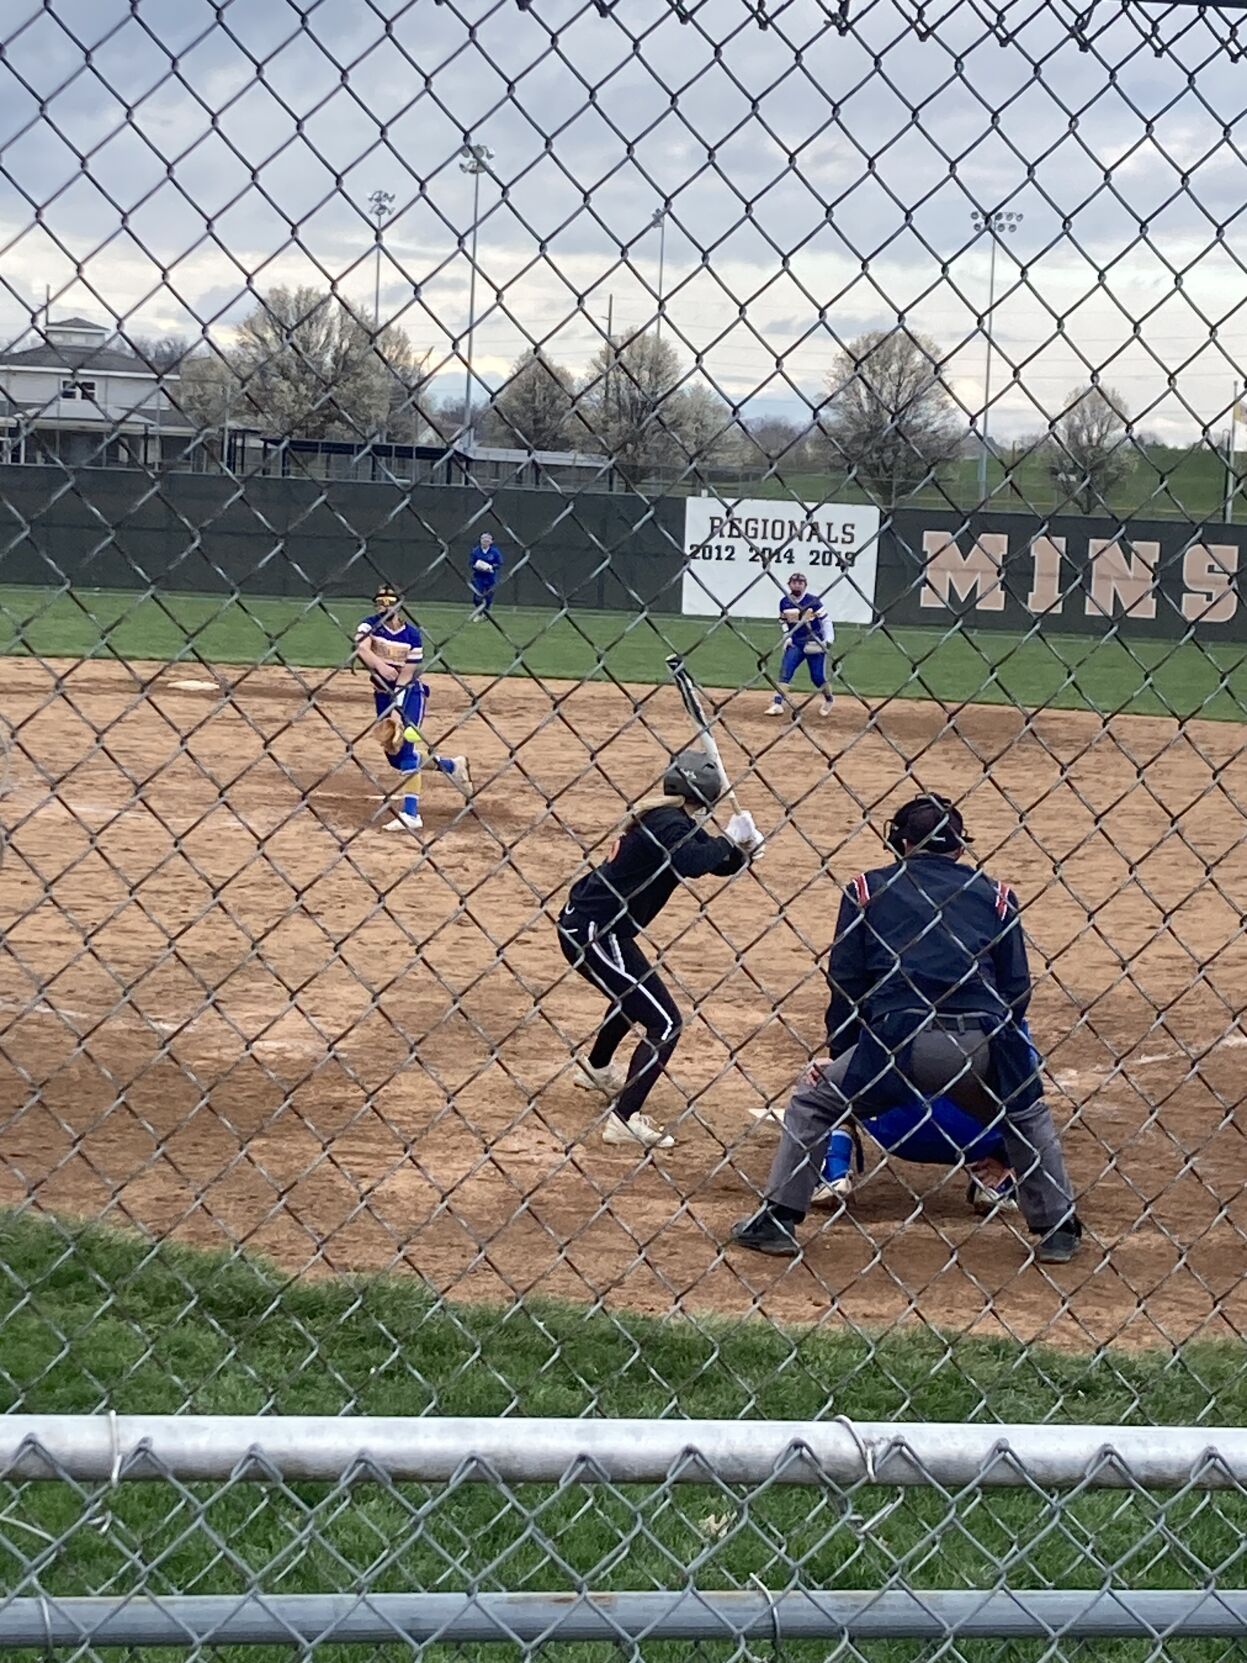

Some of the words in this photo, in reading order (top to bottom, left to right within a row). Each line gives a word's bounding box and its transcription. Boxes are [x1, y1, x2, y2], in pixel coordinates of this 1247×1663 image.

[709, 516, 855, 544] REGIONALS
[690, 544, 735, 561] 2012
[748, 546, 795, 564] 2014
[920, 530, 1239, 622] MINS
